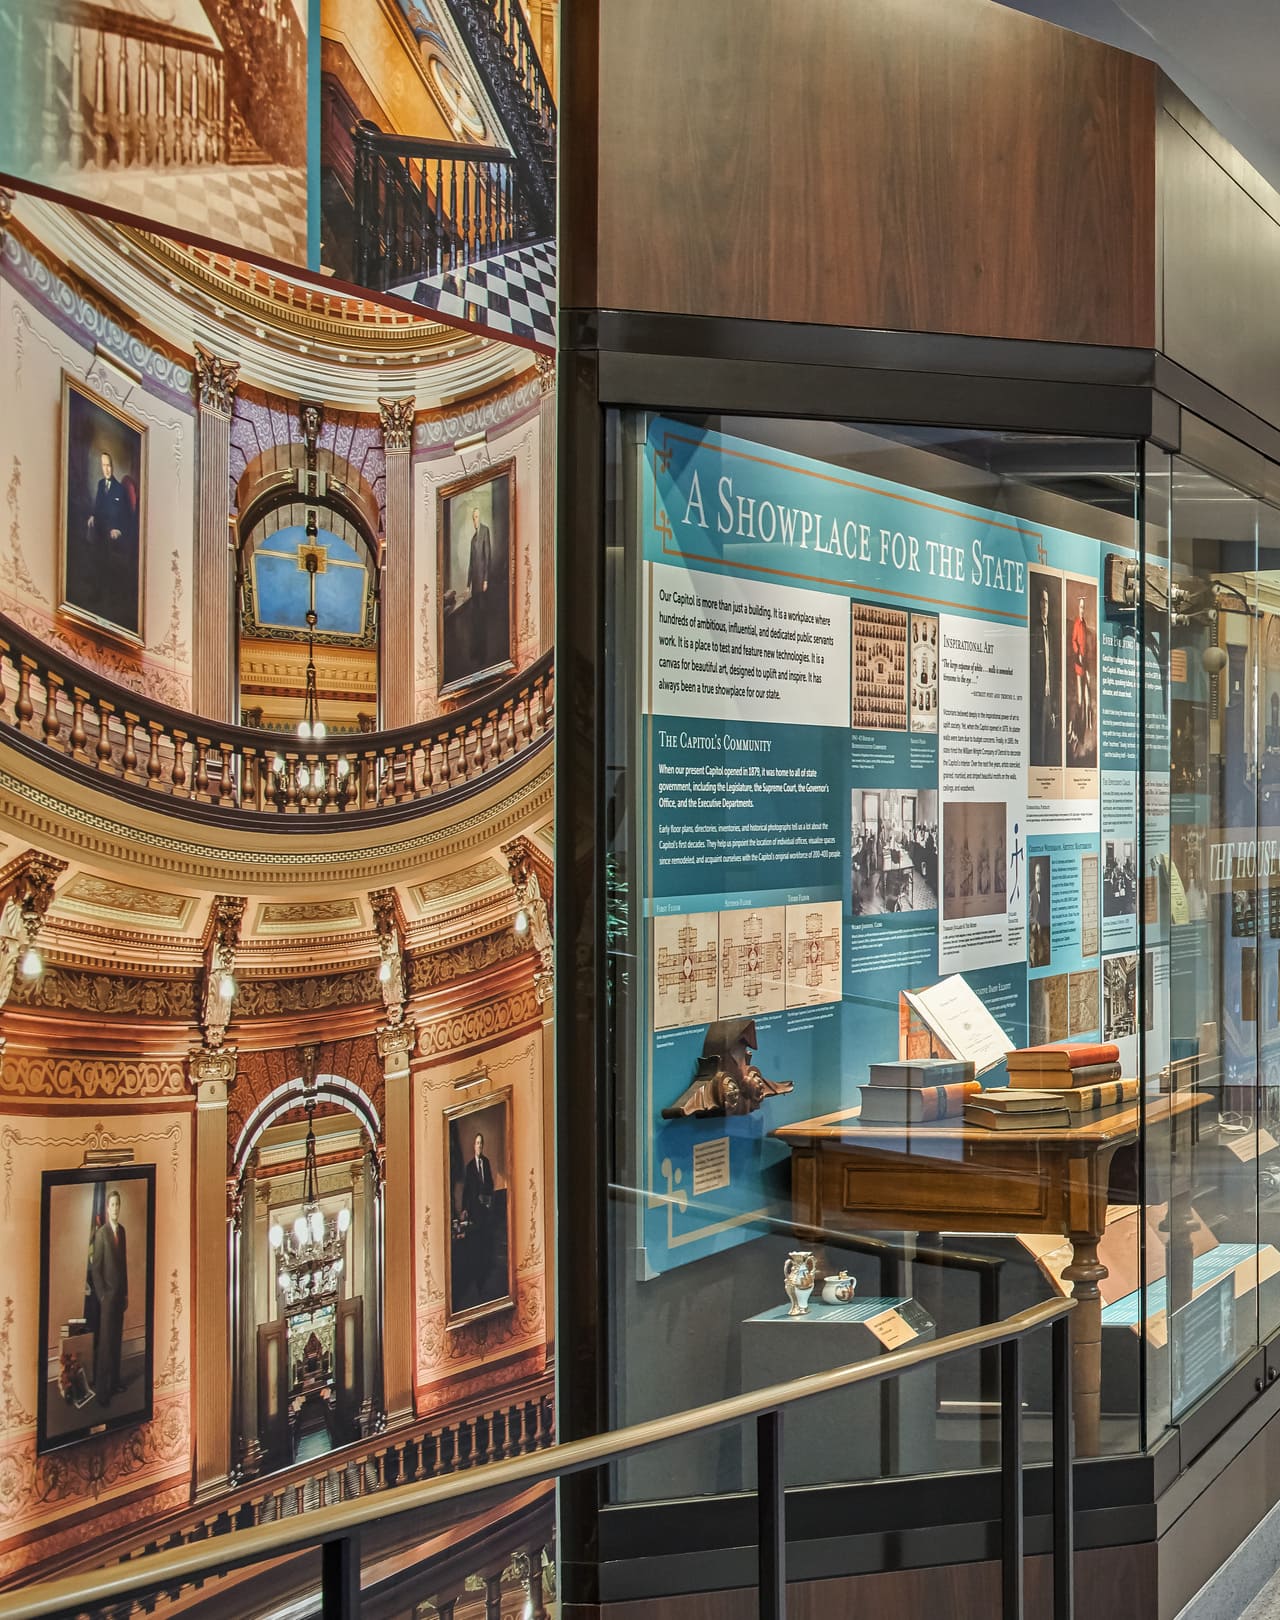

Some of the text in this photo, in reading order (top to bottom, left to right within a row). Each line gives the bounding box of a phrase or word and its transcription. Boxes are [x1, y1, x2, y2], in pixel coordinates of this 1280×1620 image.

[681, 469, 1025, 594] A SHOWPLACE FOR THE STATE
[659, 589, 672, 602] Our
[673, 591, 695, 608] Capitol
[696, 595, 701, 606] is
[702, 599, 718, 609] more
[718, 599, 732, 611] than
[732, 601, 743, 615] just
[744, 605, 748, 613] a
[748, 603, 772, 620] building.
[773, 607, 778, 618] It
[778, 608, 783, 618] is
[788, 610, 814, 626] workplace
[814, 614, 830, 626] where
[659, 612, 834, 645] hundreds of ambitious, influential, and dedicated public servants
[659, 635, 677, 647] work.
[677, 637, 683, 648] It
[683, 638, 689, 648] is
[690, 641, 694, 649] a
[695, 639, 711, 654] place
[712, 641, 719, 652] to
[719, 642, 730, 653] test
[731, 643, 742, 654] and
[743, 645, 763, 657] feature
[763, 650, 775, 658] new
[776, 649, 810, 664] technologies.
[811, 653, 815, 662] It
[816, 654, 820, 663] is
[943, 634, 983, 653] INSPIRATIONAL
[659, 658, 822, 684] canvas for beautiful art, designed to uplift and inspire. It has
[659, 678, 781, 699] always been a true showplace for our state.
[659, 731, 772, 751] THE CAPITOL'S COMMUNITY
[659, 764, 674, 774] When
[685, 765, 704, 777] present
[705, 766, 723, 777] Capitol
[724, 766, 743, 778] opened
[743, 767, 748, 776] in
[762, 767, 766, 776] it
[776, 768, 789, 776] home
[789, 768, 794, 776] to
[800, 768, 806, 777] of
[806, 768, 817, 777] state
[677, 798, 688, 807] and
[688, 798, 697, 807] the
[698, 798, 722, 807] Executive
[1210, 842, 1234, 881] THE
[1236, 840, 1276, 879] HOUSE
